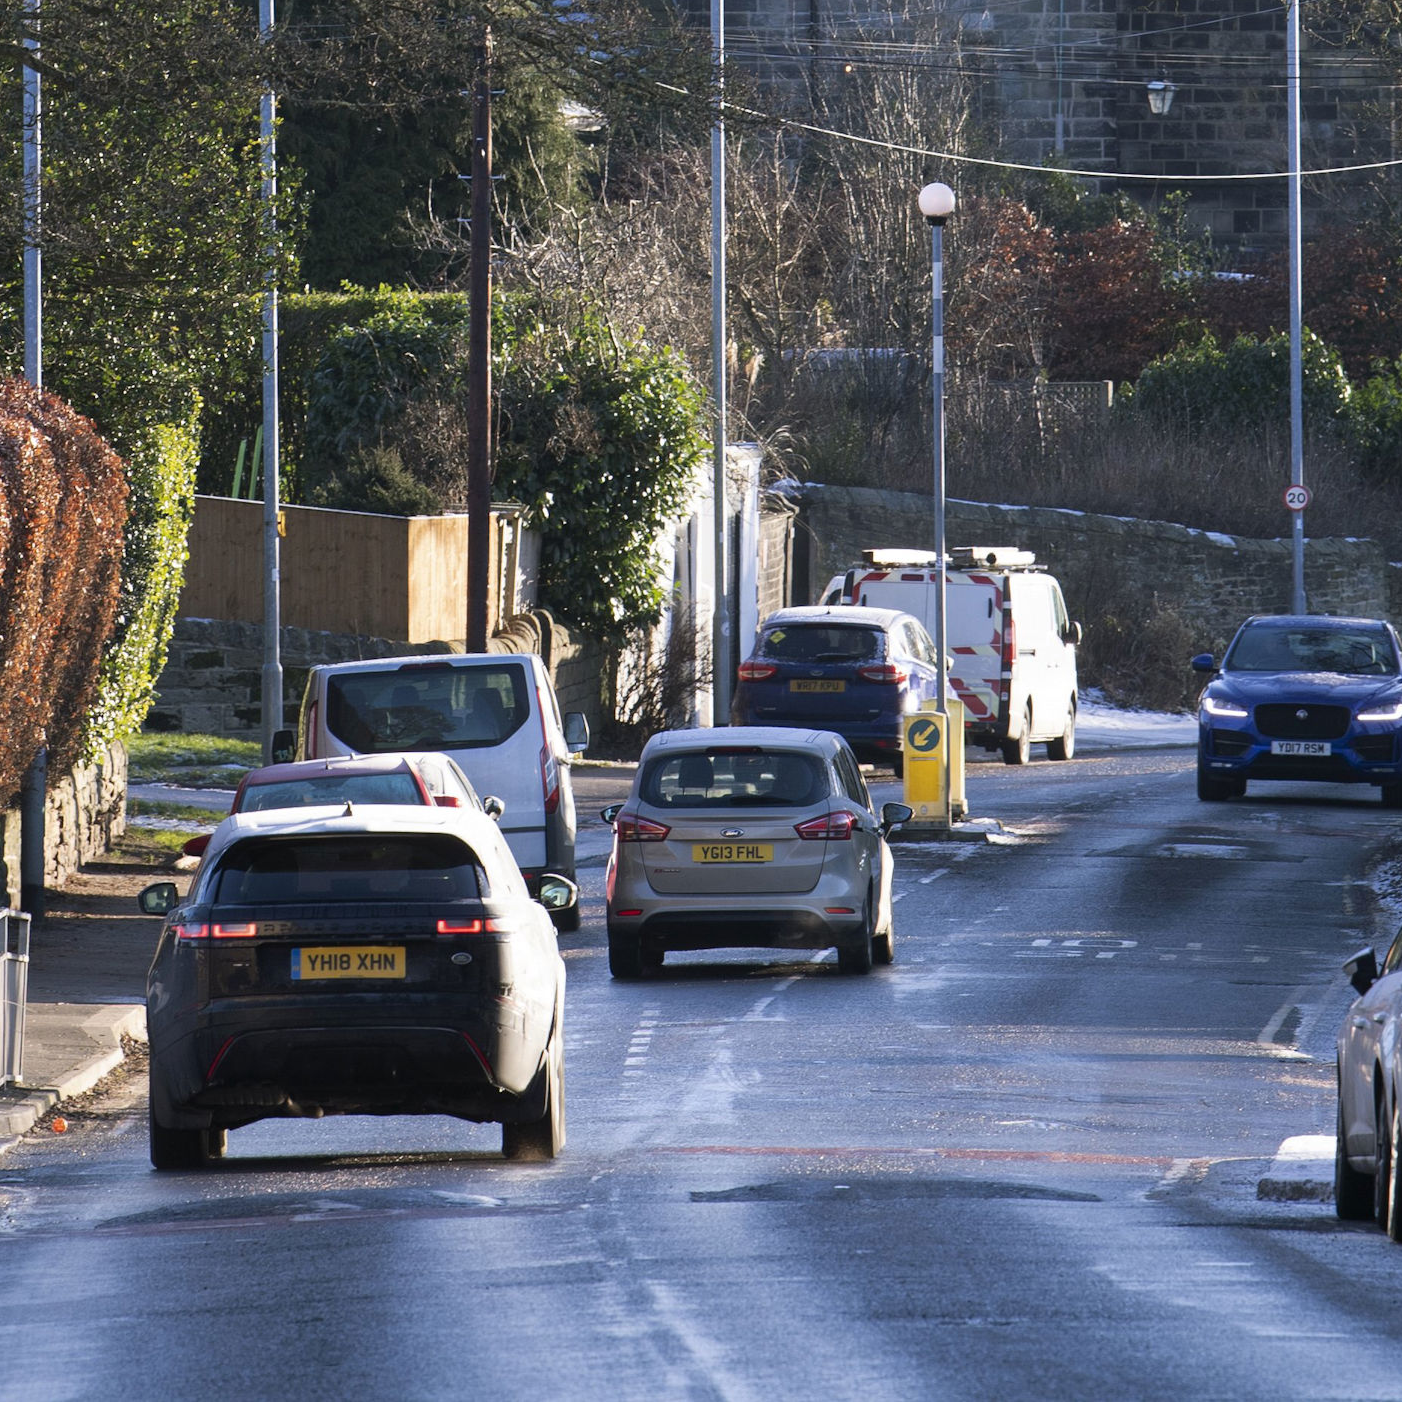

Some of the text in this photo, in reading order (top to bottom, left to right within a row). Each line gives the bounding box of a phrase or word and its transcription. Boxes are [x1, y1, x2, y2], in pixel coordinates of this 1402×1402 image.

[1288, 492, 1306, 504] 20
[1278, 742, 1325, 754] YD17 RSM
[701, 846, 764, 860] YG13 FHL
[307, 953, 351, 972] YH18
[356, 953, 396, 972] XHN
